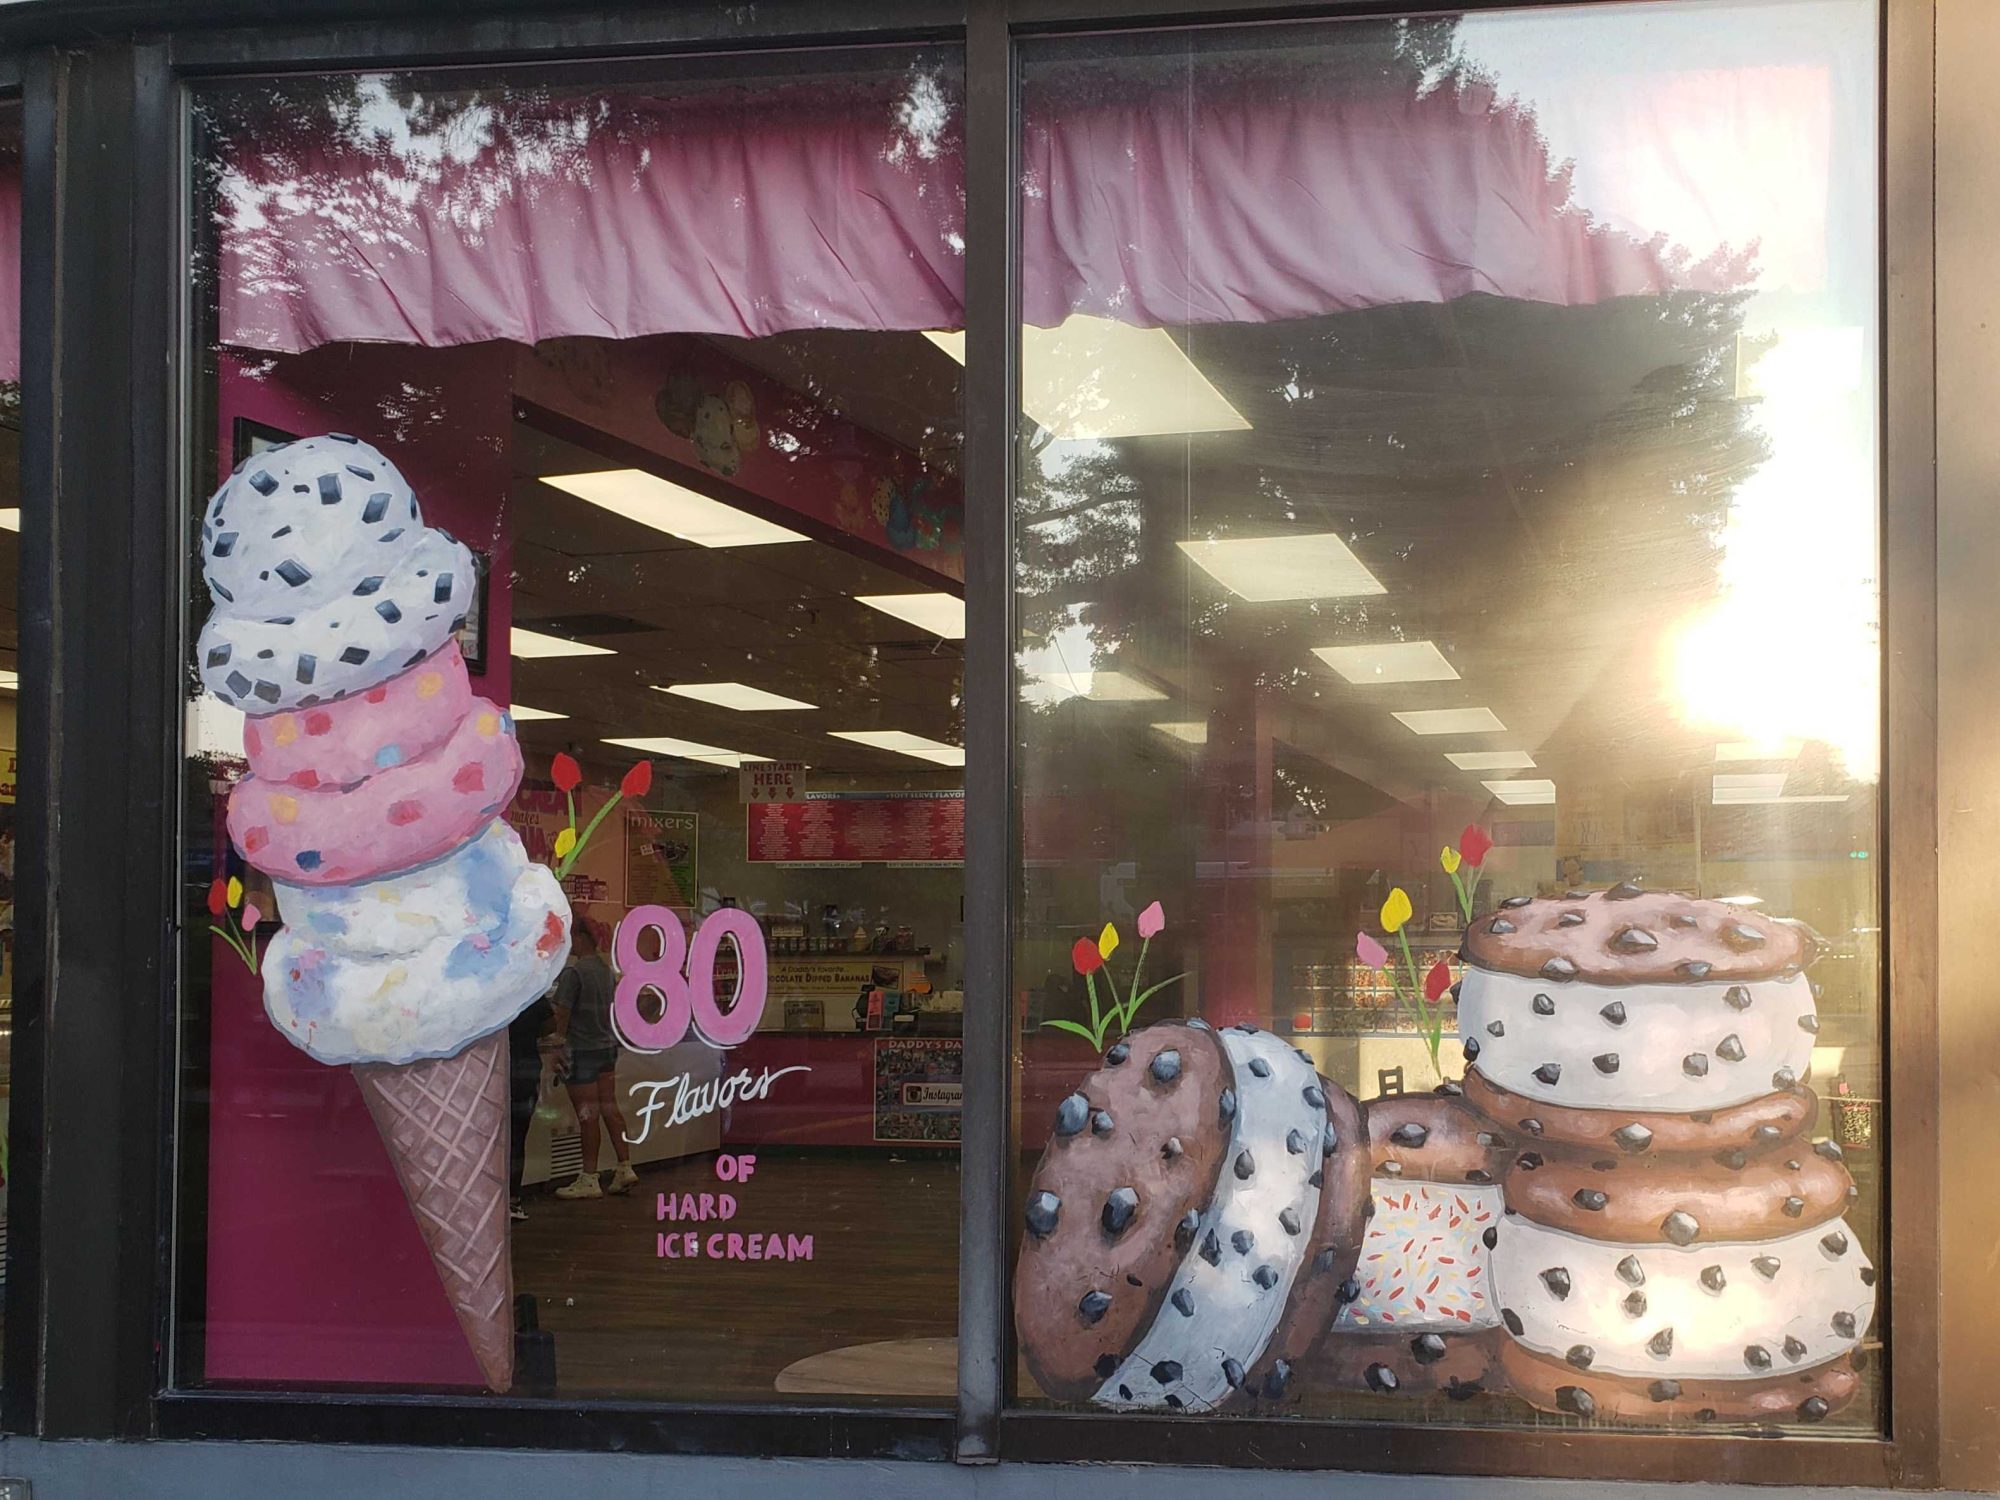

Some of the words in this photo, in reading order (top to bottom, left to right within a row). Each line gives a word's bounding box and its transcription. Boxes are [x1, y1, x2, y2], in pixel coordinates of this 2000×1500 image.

[743, 762, 767, 772] LINE
[768, 762, 804, 771] STARTS
[754, 773, 793, 786] HERE
[630, 815, 694, 830] mixers
[611, 904, 767, 1054] 80
[834, 973, 870, 983] BANANAS
[888, 1040, 942, 1049] DADDY'S
[622, 1066, 812, 1144] Flavors
[716, 1154, 757, 1183] OF
[656, 1192, 737, 1222] HARD
[656, 1232, 699, 1259] ICE
[706, 1232, 814, 1262] CREAM
